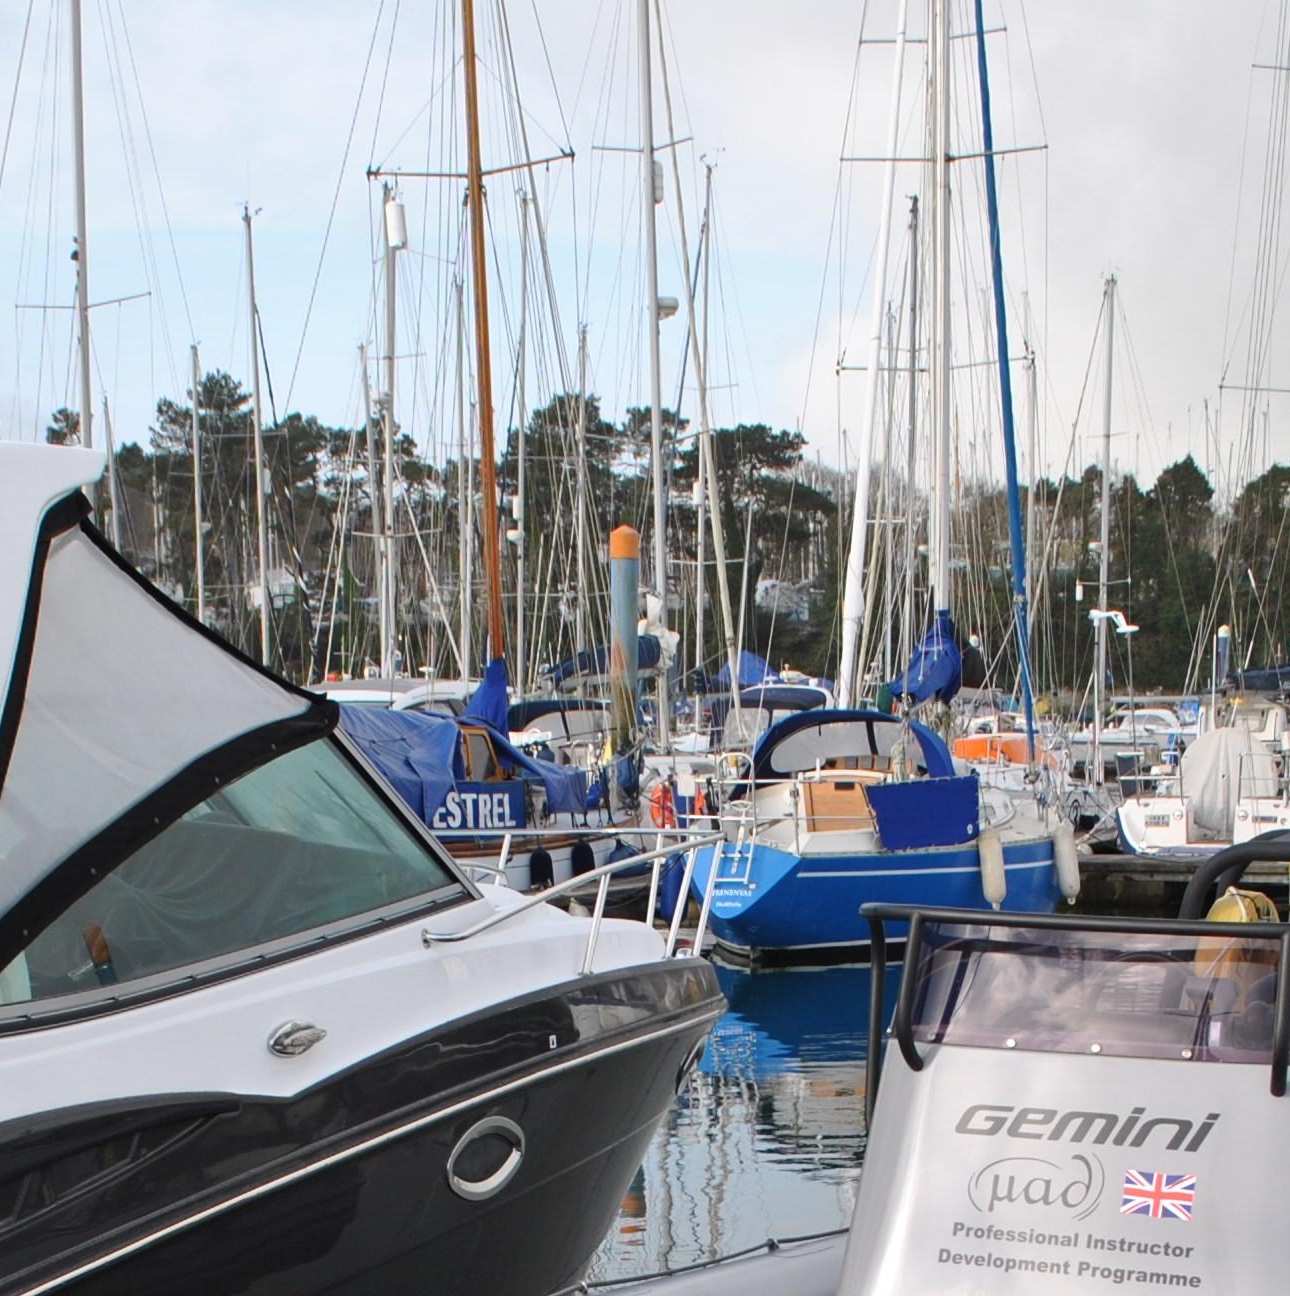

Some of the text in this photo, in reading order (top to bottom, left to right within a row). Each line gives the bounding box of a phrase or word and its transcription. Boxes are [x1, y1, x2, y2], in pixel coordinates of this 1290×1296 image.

[952, 1222, 1195, 1259] Professional Instructor
[938, 1248, 1202, 1288] Development Programme
